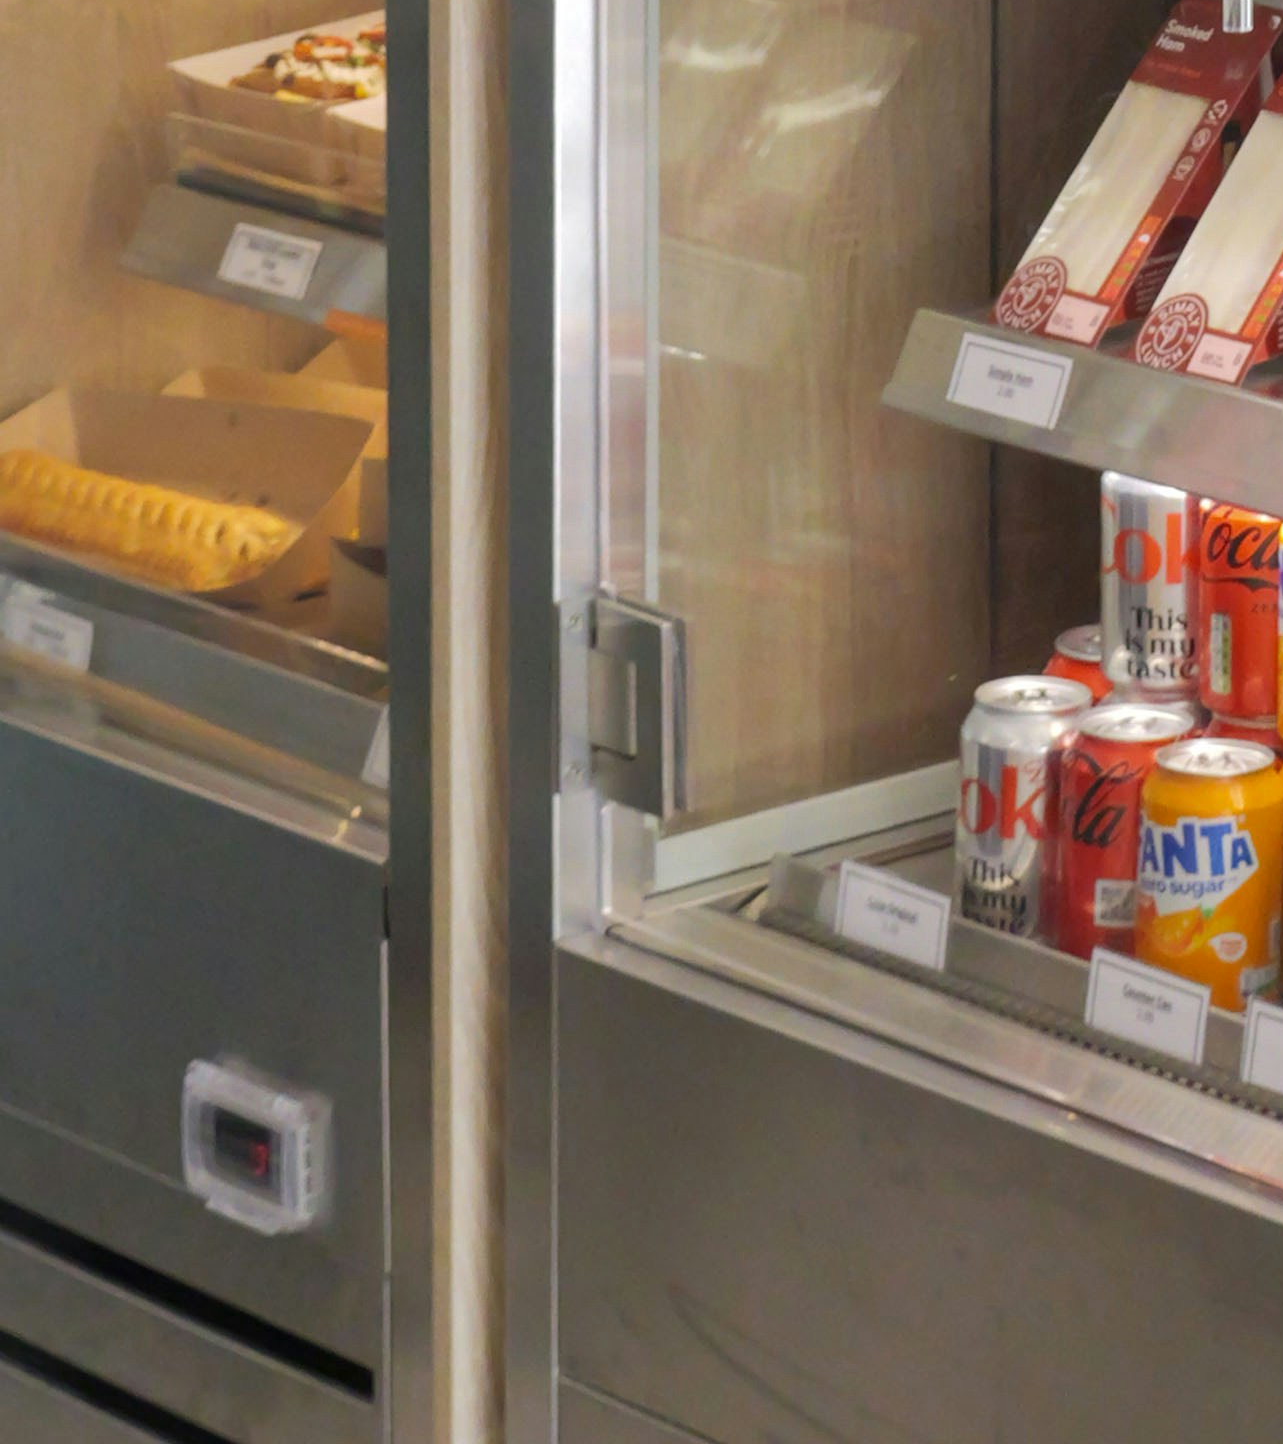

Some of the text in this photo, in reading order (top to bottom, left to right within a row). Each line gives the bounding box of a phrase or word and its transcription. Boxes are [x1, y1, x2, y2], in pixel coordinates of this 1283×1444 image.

[1164, 18, 1215, 43] Smoked
[1155, 34, 1186, 54] Ham
[1016, 258, 1062, 293] SIMPLY
[1158, 296, 1203, 331] SIMPLY
[1139, 339, 1187, 371] LUNCH
[1131, 606, 1188, 631] This
[1124, 632, 1196, 660] is my
[1126, 656, 1196, 681] taste
[1168, 877, 1226, 900] sugar
